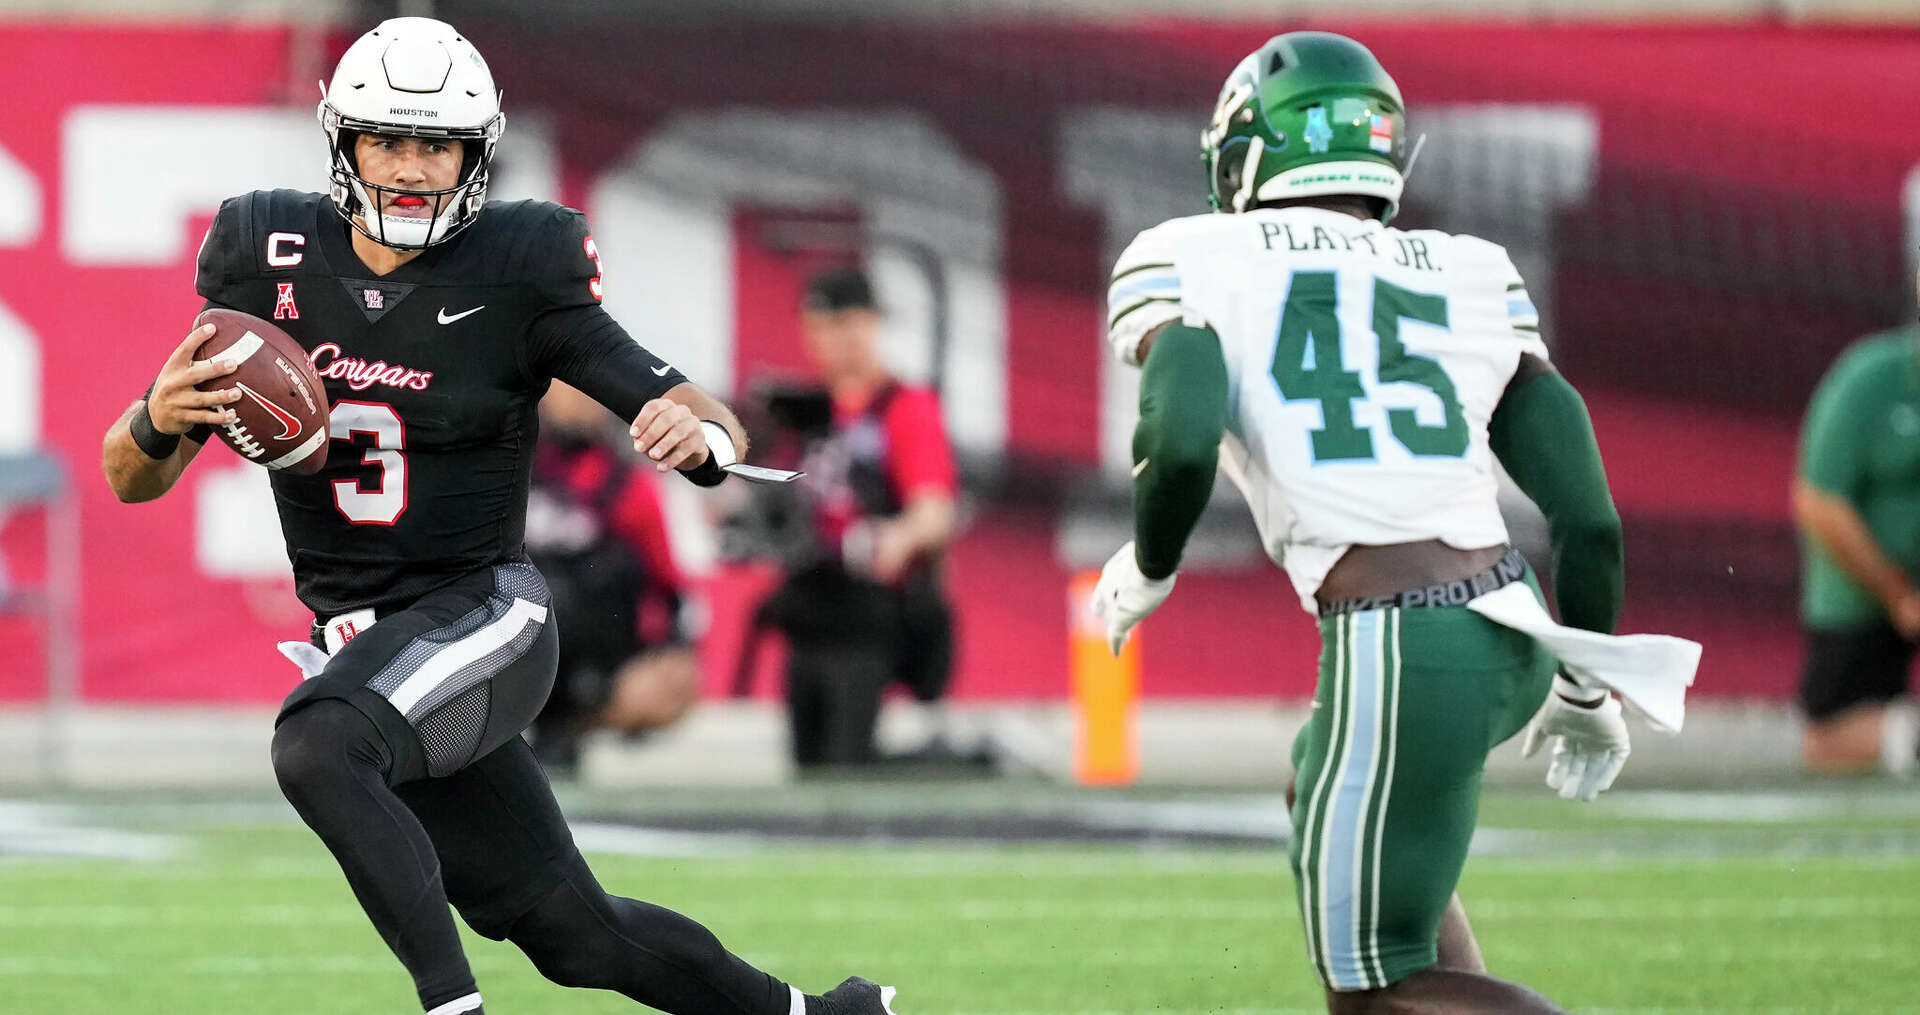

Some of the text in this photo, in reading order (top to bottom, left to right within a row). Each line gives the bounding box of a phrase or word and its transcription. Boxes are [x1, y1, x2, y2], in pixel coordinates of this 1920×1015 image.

[389, 107, 438, 118] HOUSTON
[267, 231, 306, 267] C
[1394, 237, 1443, 272] JR.
[274, 282, 300, 319] A
[309, 342, 433, 391] Cougars
[1267, 270, 1471, 468] 45
[329, 399, 409, 526] 3
[1402, 583, 1469, 609] PRO
